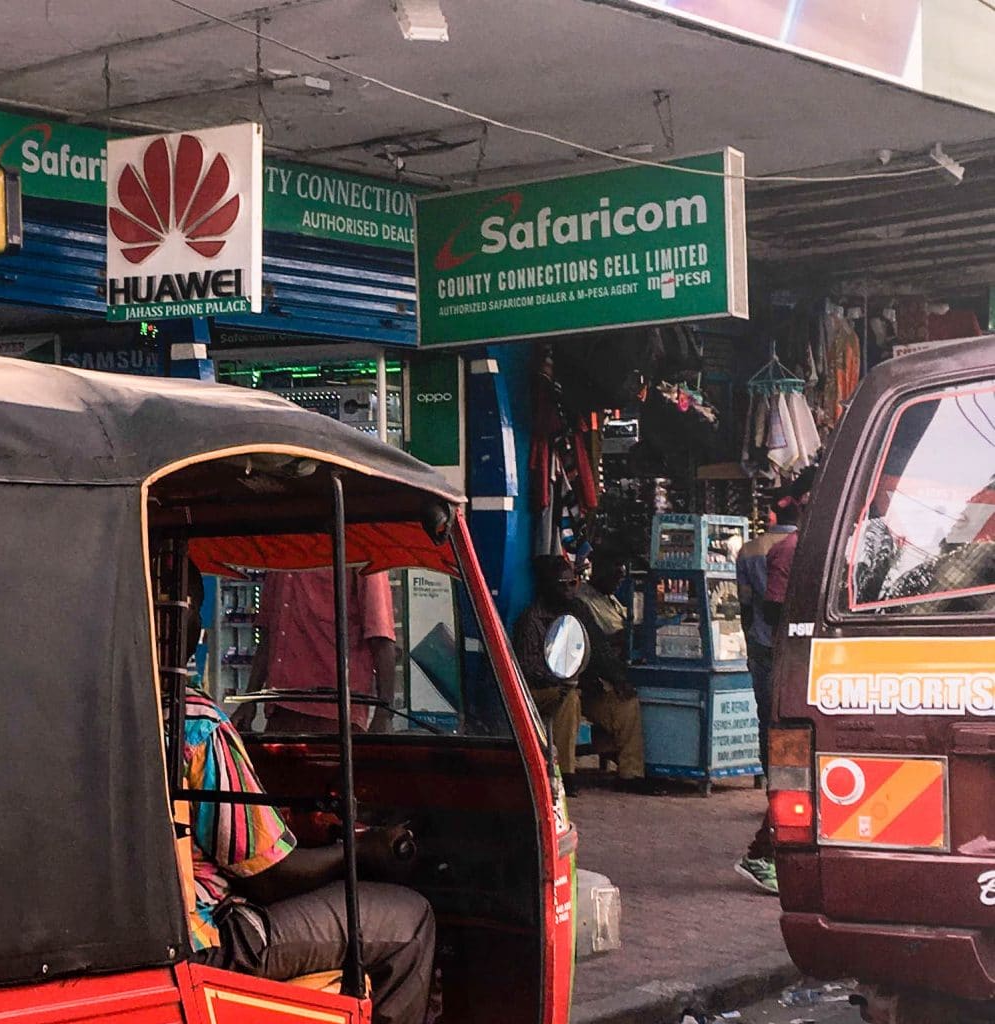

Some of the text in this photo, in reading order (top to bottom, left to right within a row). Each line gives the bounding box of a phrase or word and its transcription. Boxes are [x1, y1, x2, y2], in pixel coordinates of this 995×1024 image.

[21, 139, 107, 182] Safari
[265, 166, 415, 217] TY CONNECTION
[302, 210, 379, 238] AUTHORISED
[480, 194, 708, 254] Safaricom
[108, 268, 243, 305] HUAWEI
[437, 243, 708, 300] COUNTY CONNECTIONS CELL LIMITED
[125, 299, 247, 321] JAHASS PHONE PALACE
[438, 282, 639, 316] AUTHORIZED SAFARICOM DEALER & M-PESA AGENT
[788, 622, 815, 637] PSV
